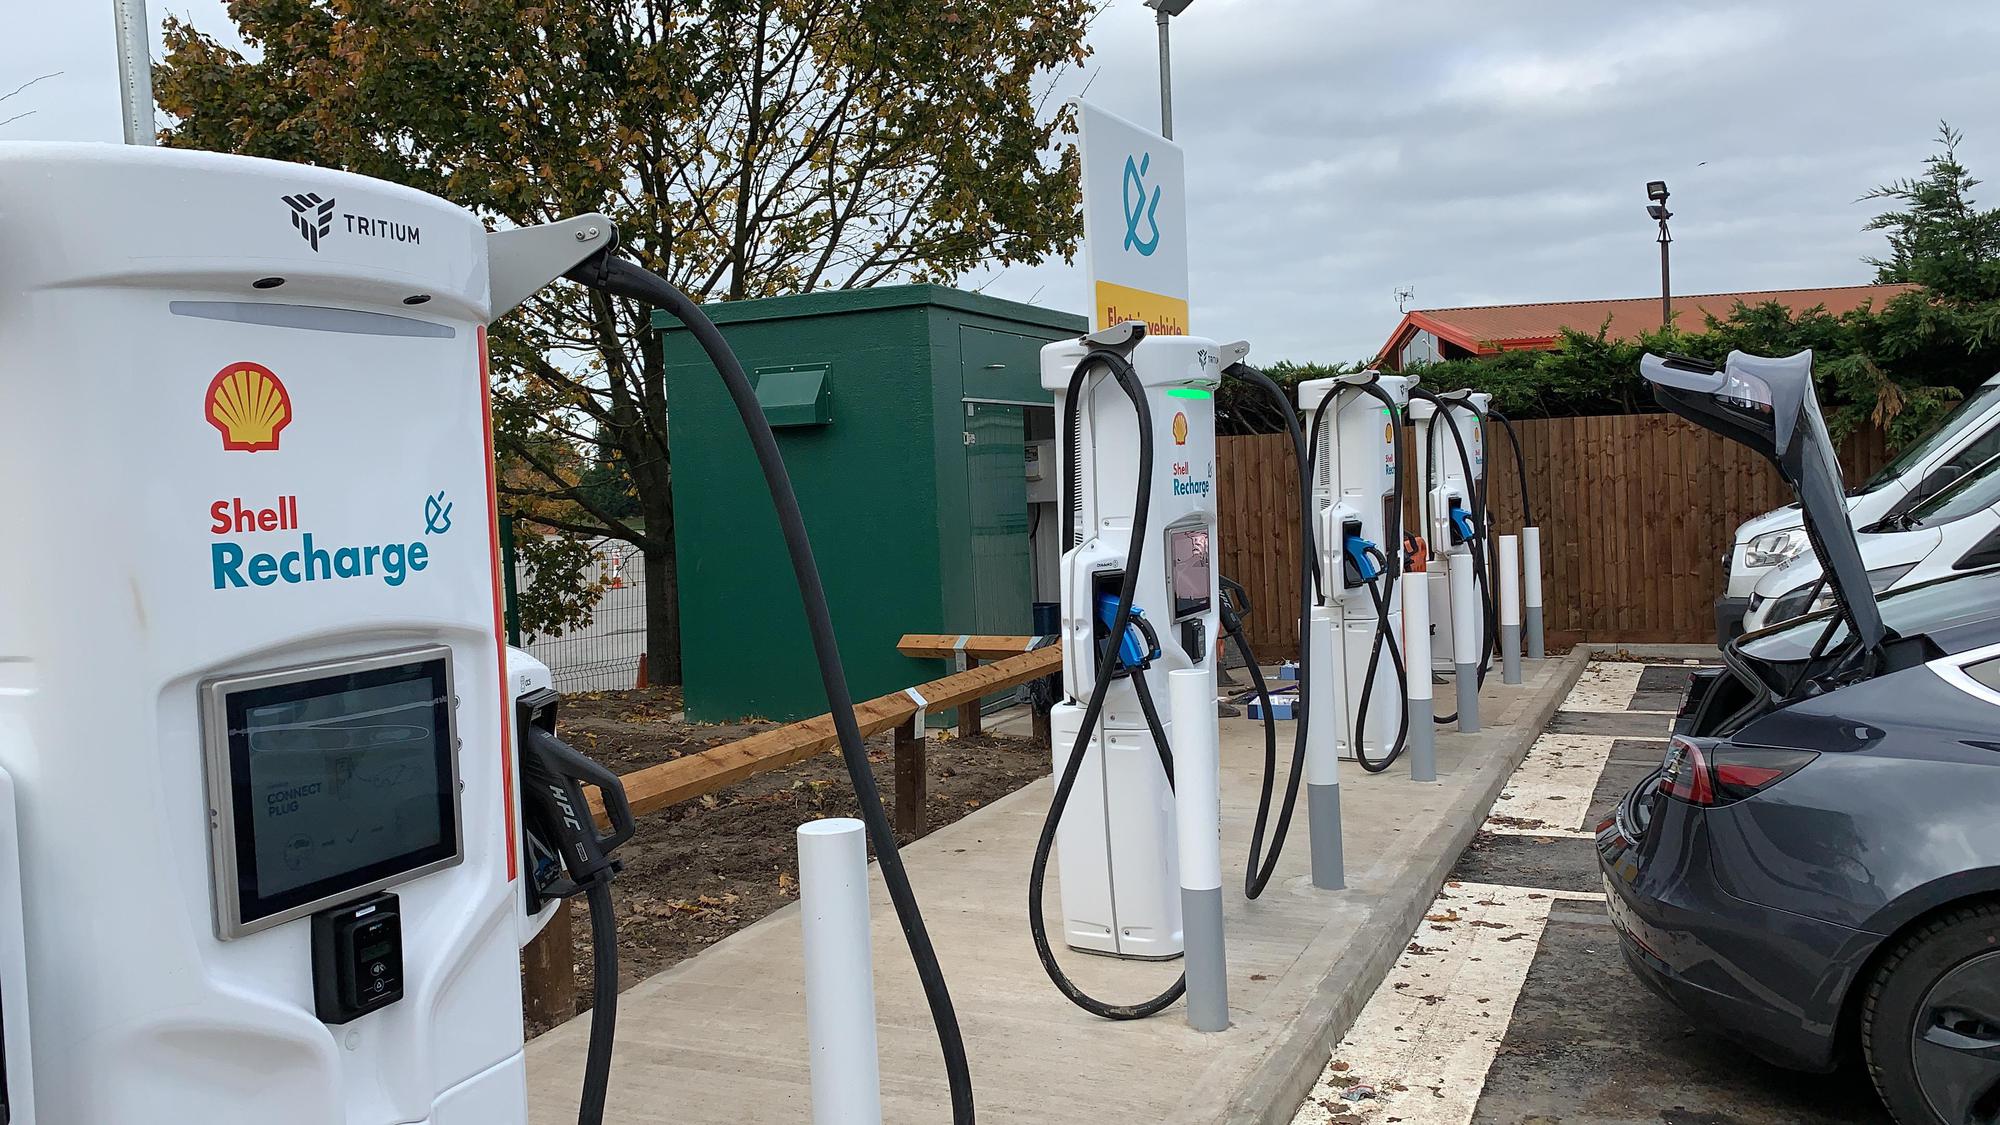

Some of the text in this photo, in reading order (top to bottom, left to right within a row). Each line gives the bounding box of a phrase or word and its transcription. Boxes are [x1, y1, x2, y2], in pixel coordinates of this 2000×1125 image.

[343, 213, 421, 245] TRITIUM
[1173, 461, 1189, 476] Shell
[1173, 475, 1209, 498] Recharge
[210, 495, 298, 535] Shell
[211, 532, 429, 590] Recharge
[267, 782, 322, 804] CONNECT
[268, 800, 300, 818] PLUG
[549, 784, 581, 831] HPC
